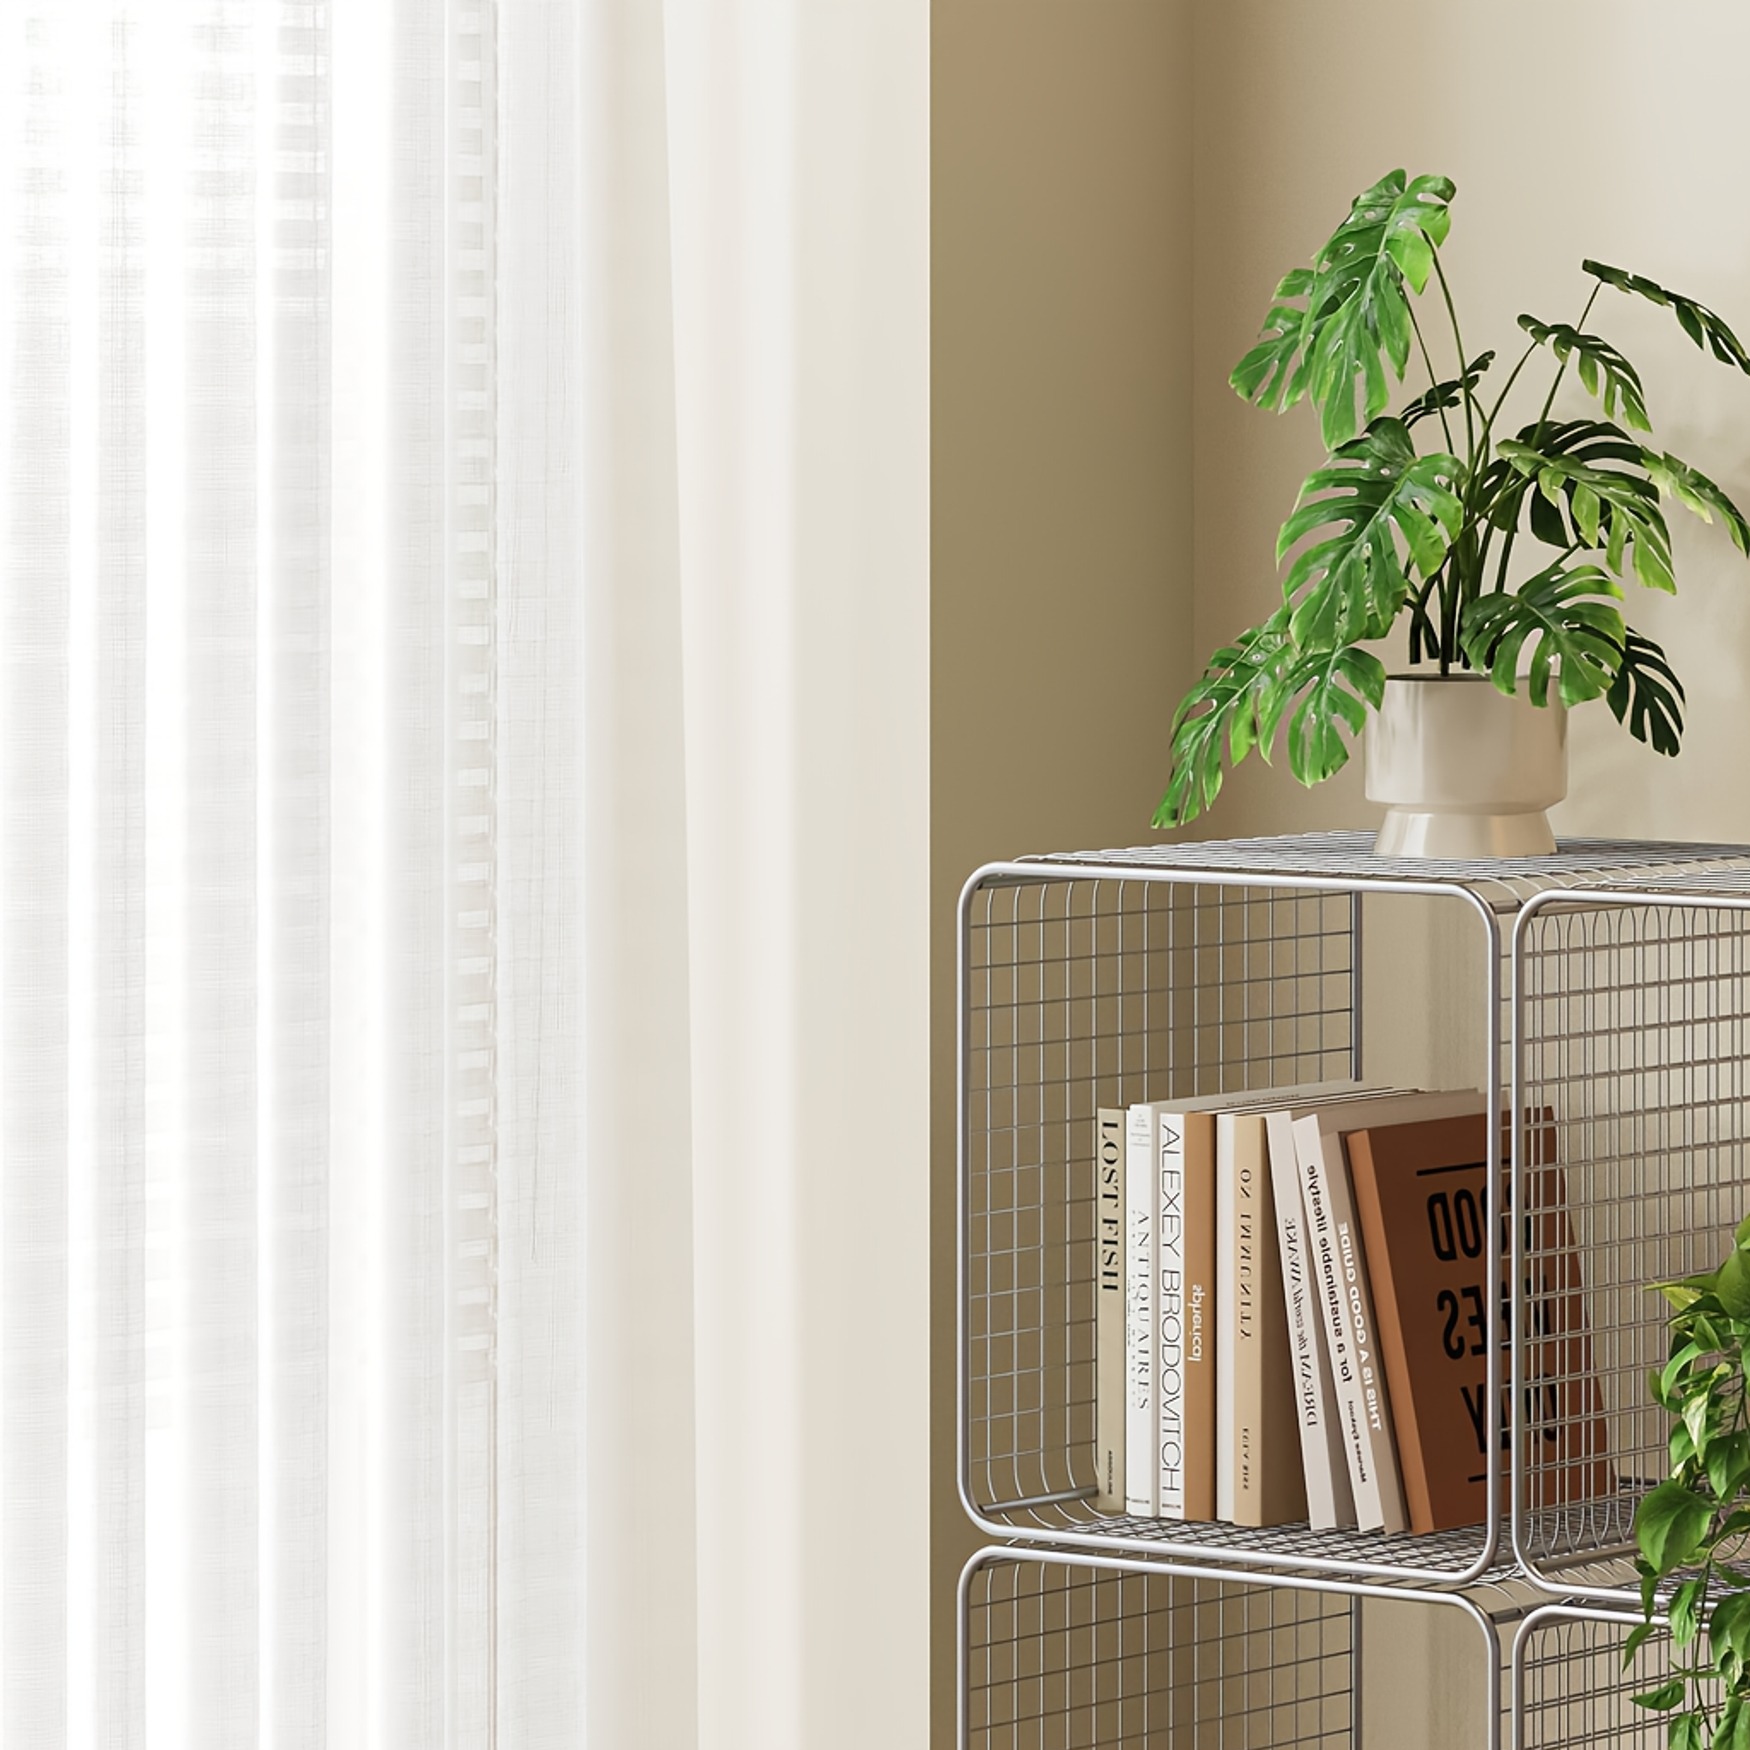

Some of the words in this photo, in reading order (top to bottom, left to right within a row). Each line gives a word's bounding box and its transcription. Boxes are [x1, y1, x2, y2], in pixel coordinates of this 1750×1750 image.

[1102, 1122, 1119, 1209] LOST
[1162, 1124, 1181, 1258] ALEXEY
[1102, 1218, 1119, 1291] FISH
[1134, 1211, 1150, 1409] ANTIQUAIRES
[1161, 1269, 1182, 1492] BRODOVITCH
